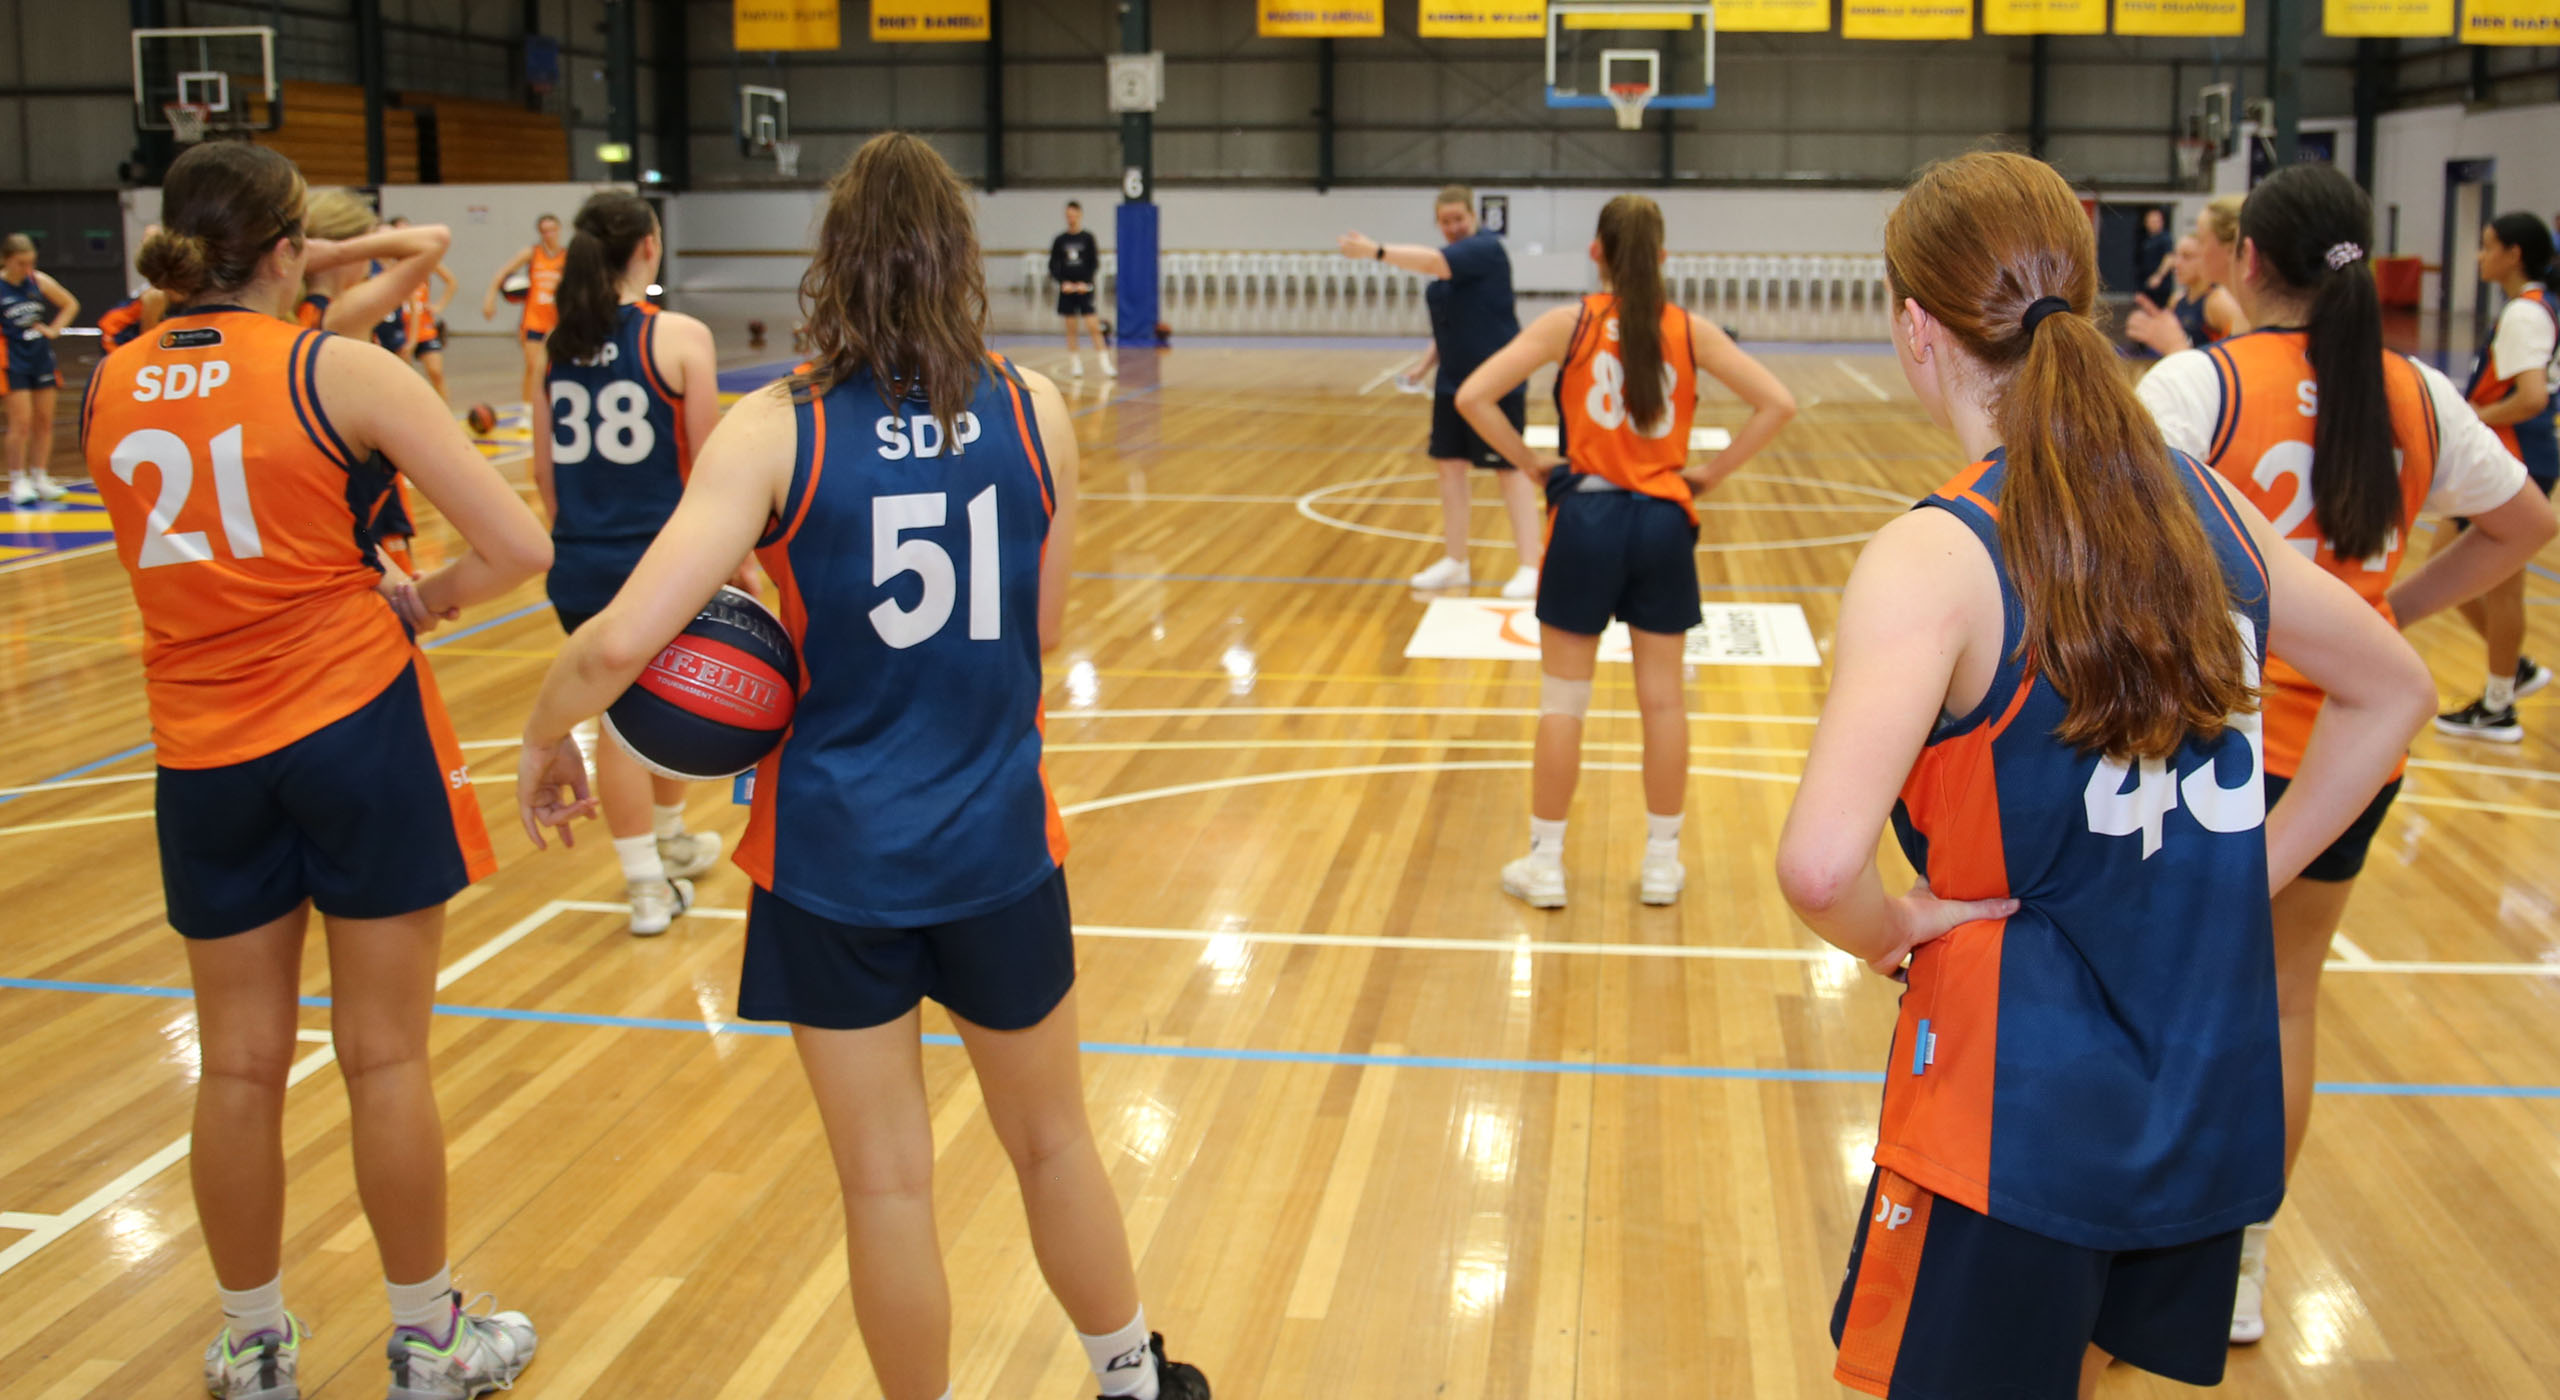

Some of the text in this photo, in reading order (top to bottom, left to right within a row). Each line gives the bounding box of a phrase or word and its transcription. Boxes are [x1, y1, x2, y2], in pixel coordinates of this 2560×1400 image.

[1124, 169, 1144, 199] 6
[132, 360, 231, 402] SDP
[551, 380, 656, 465] 38
[875, 411, 982, 461] SDP
[110, 423, 265, 569] 21
[868, 484, 1001, 650] 51
